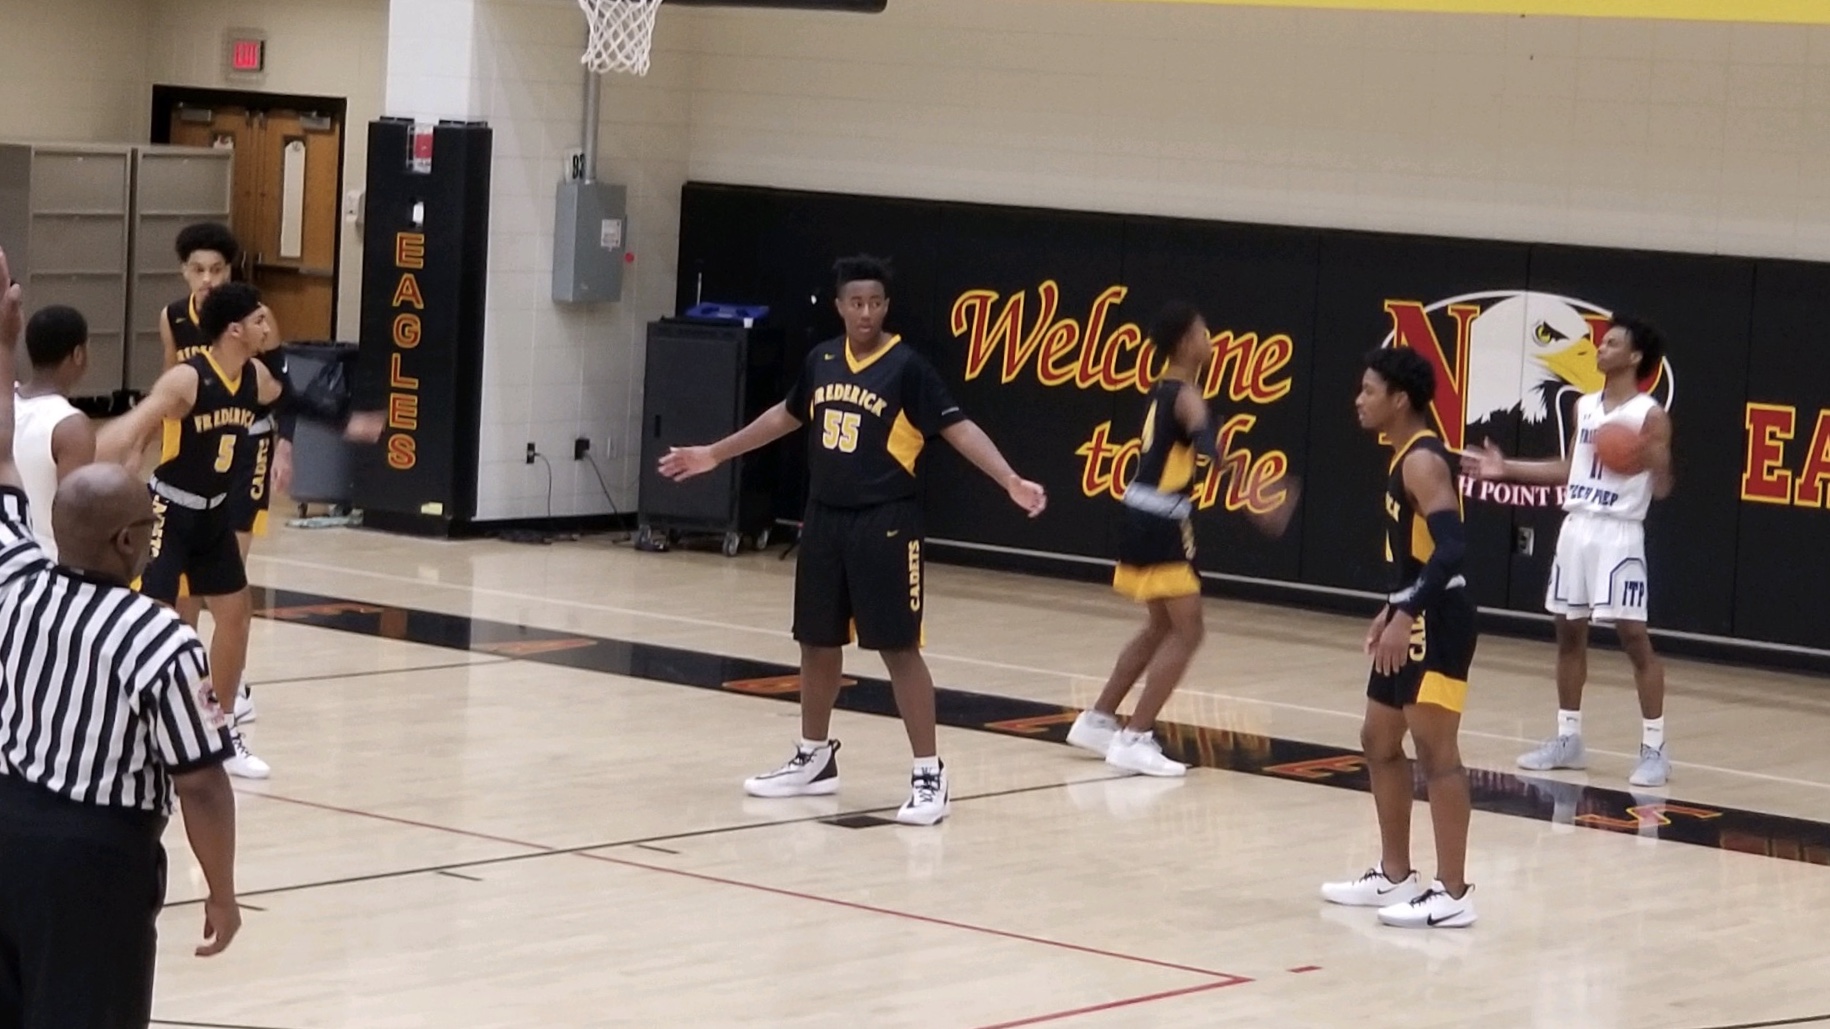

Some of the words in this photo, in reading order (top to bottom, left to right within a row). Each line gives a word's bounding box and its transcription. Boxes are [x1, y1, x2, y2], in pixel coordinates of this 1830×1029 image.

[388, 232, 425, 470] EAGLES
[810, 383, 888, 421] REDERICK
[822, 408, 862, 453] 55
[214, 434, 237, 473] 5
[1188, 413, 1288, 514] he
[1480, 479, 1551, 507] POINT
[1622, 580, 1645, 607] ITP
